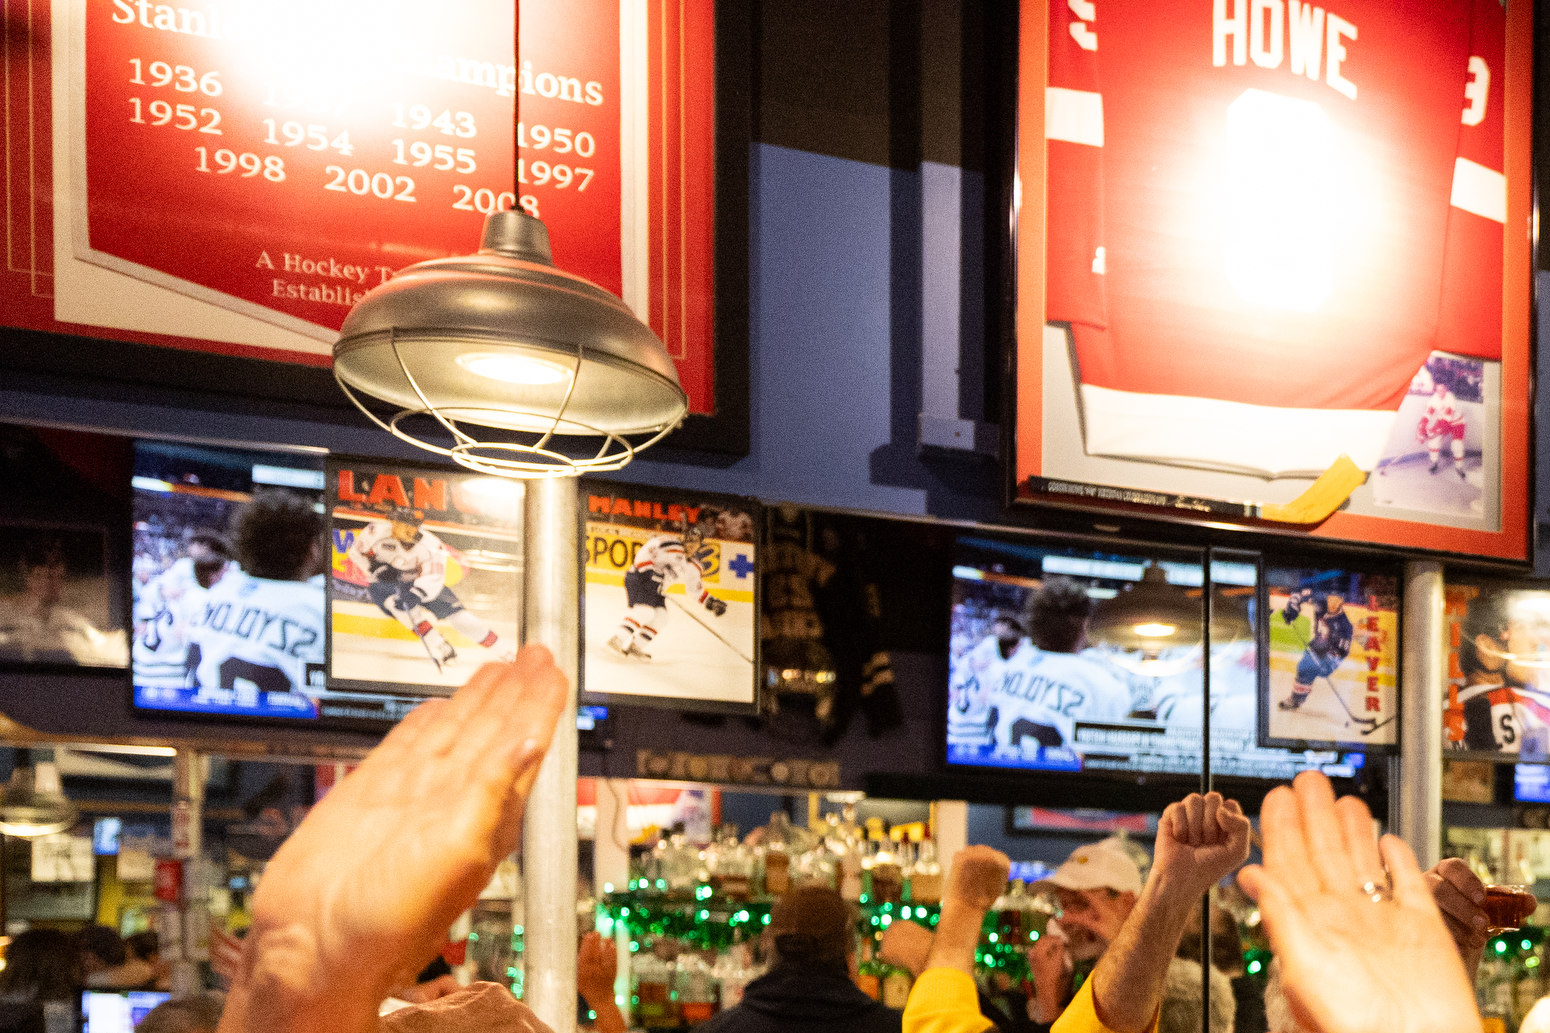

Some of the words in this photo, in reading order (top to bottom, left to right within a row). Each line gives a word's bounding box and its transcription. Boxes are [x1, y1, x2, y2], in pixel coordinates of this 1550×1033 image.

[1212, 0, 1358, 101] HOWE
[128, 58, 223, 97] 1936
[391, 101, 477, 138] 1943
[516, 122, 595, 158] 1950
[128, 97, 223, 135] 1952
[262, 118, 354, 156] 1954
[391, 139, 477, 175] 1955
[516, 158, 595, 192] 1997
[194, 146, 287, 183] 1998
[323, 165, 417, 203] 2002
[256, 250, 275, 270] A
[283, 252, 369, 285] Hockey
